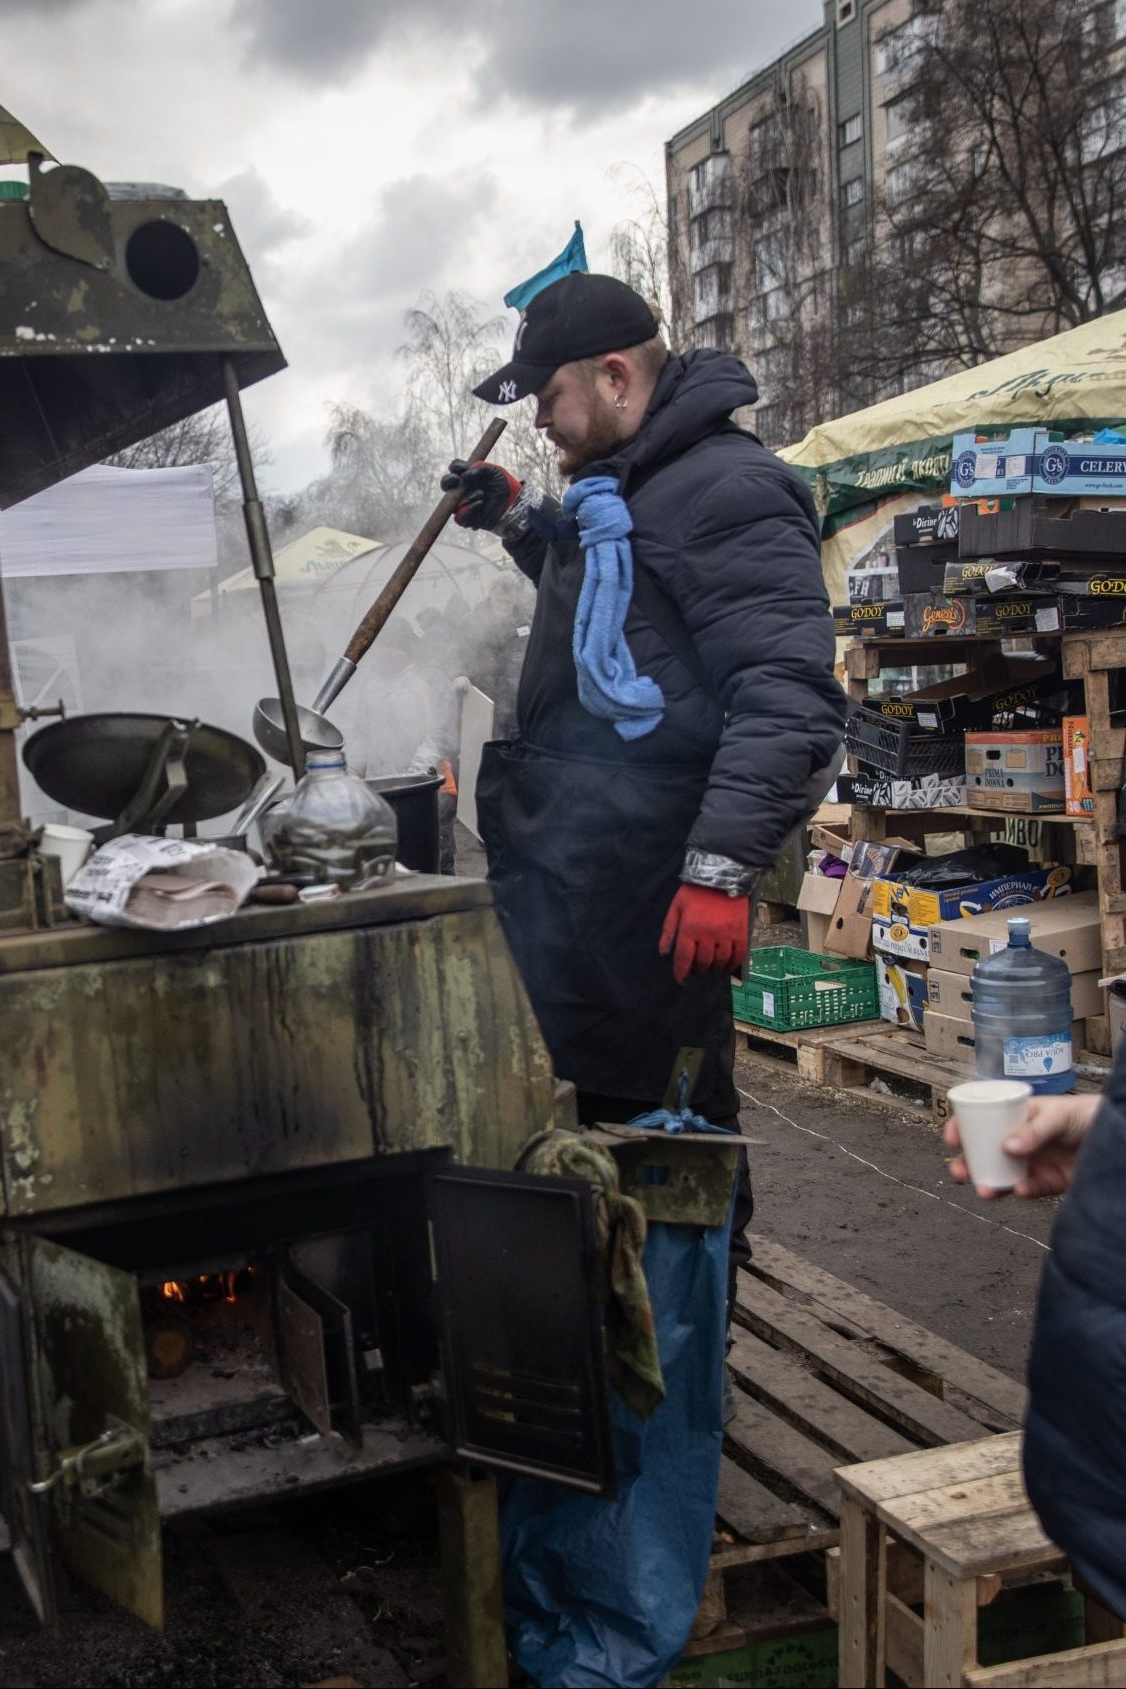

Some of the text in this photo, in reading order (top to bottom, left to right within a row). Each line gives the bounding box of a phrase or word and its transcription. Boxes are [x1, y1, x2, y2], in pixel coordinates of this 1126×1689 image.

[1090, 580, 1126, 595] GOD
[851, 606, 884, 620] GODOY
[995, 603, 1032, 619] GODOY
[881, 705, 913, 716] GODOY
